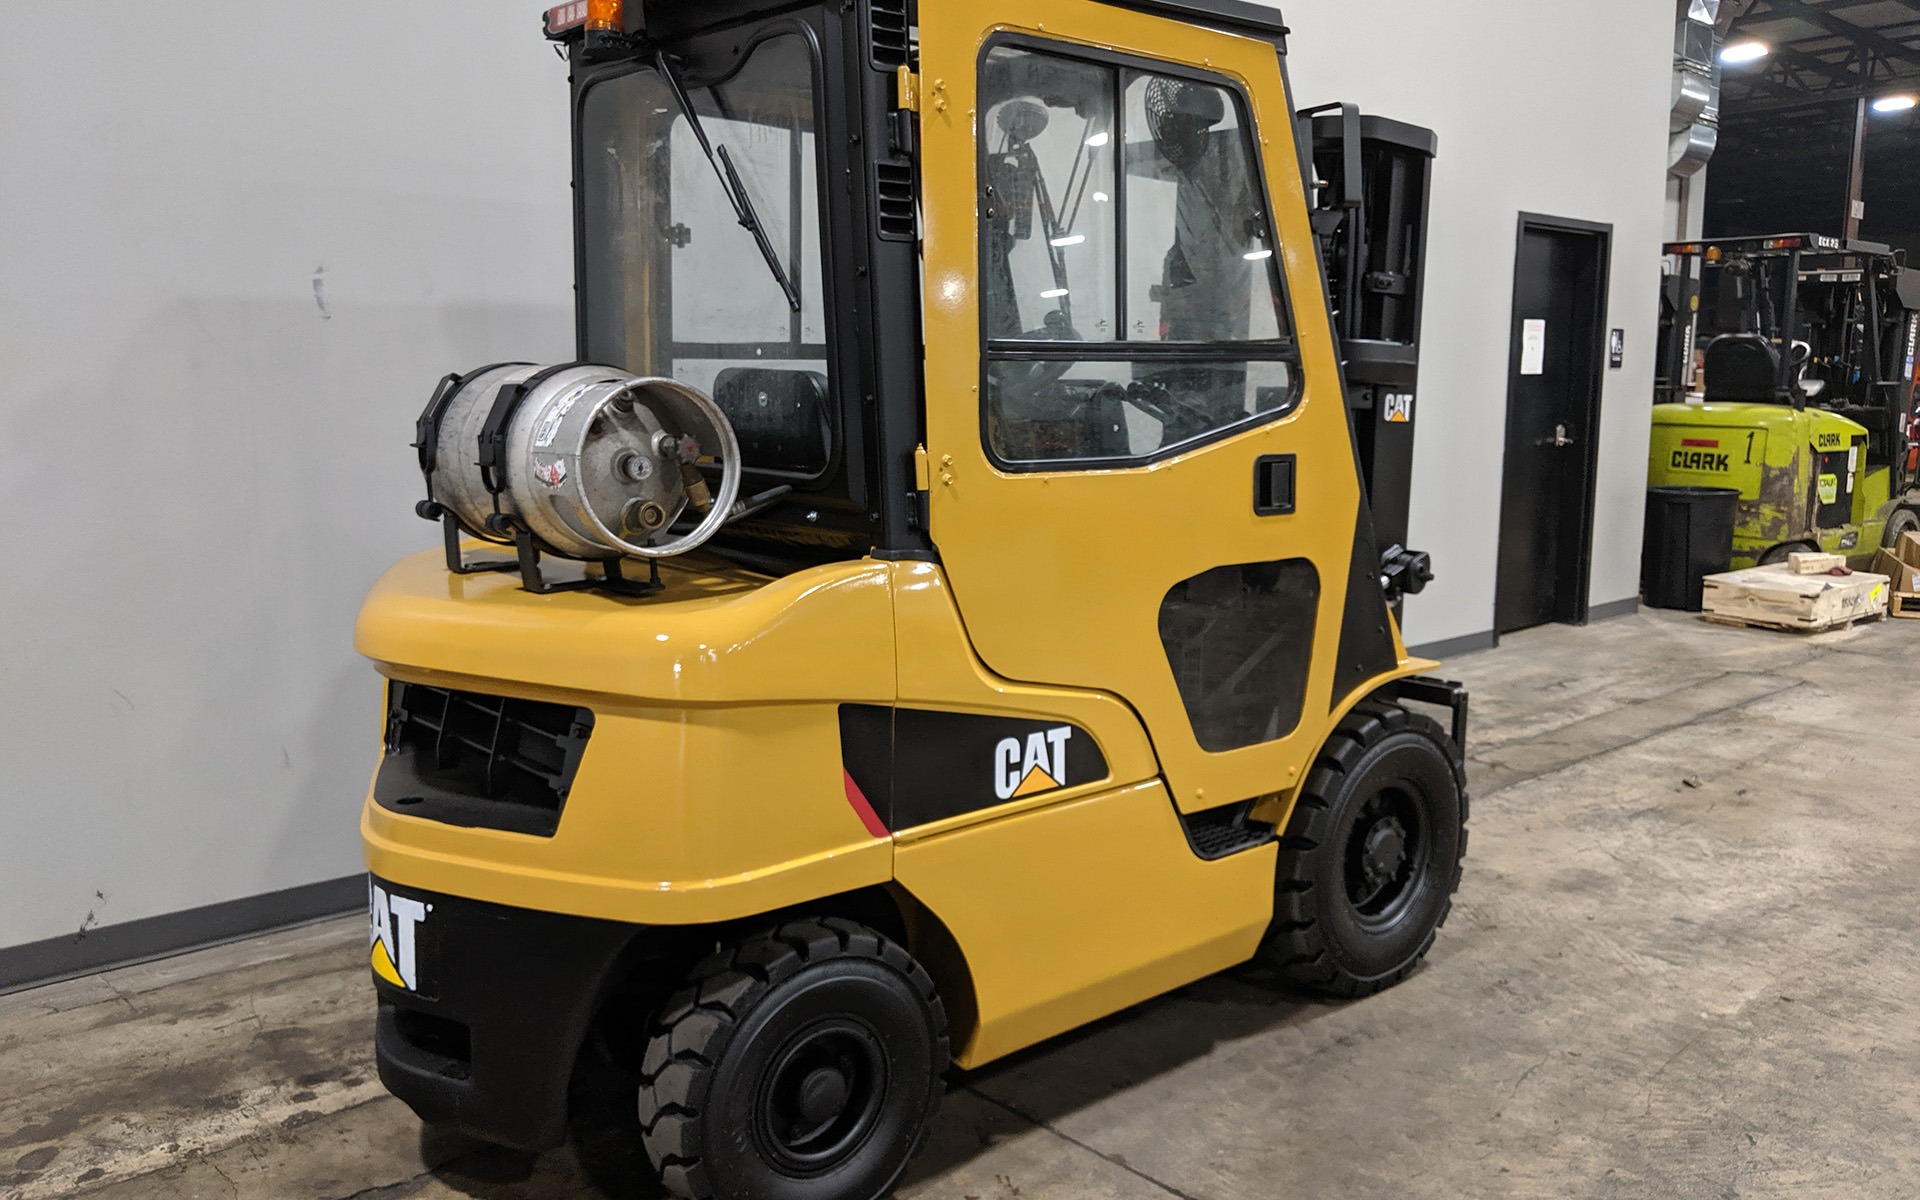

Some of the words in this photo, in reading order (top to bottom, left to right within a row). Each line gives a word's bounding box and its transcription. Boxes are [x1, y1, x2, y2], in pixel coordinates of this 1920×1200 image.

[1906, 313, 1918, 356] CLARK
[1384, 393, 1413, 422] CAT
[1819, 433, 1841, 447] CLARK
[1671, 450, 1729, 472] CLARK
[995, 725, 1071, 800] CAT
[369, 870, 426, 991] AT
